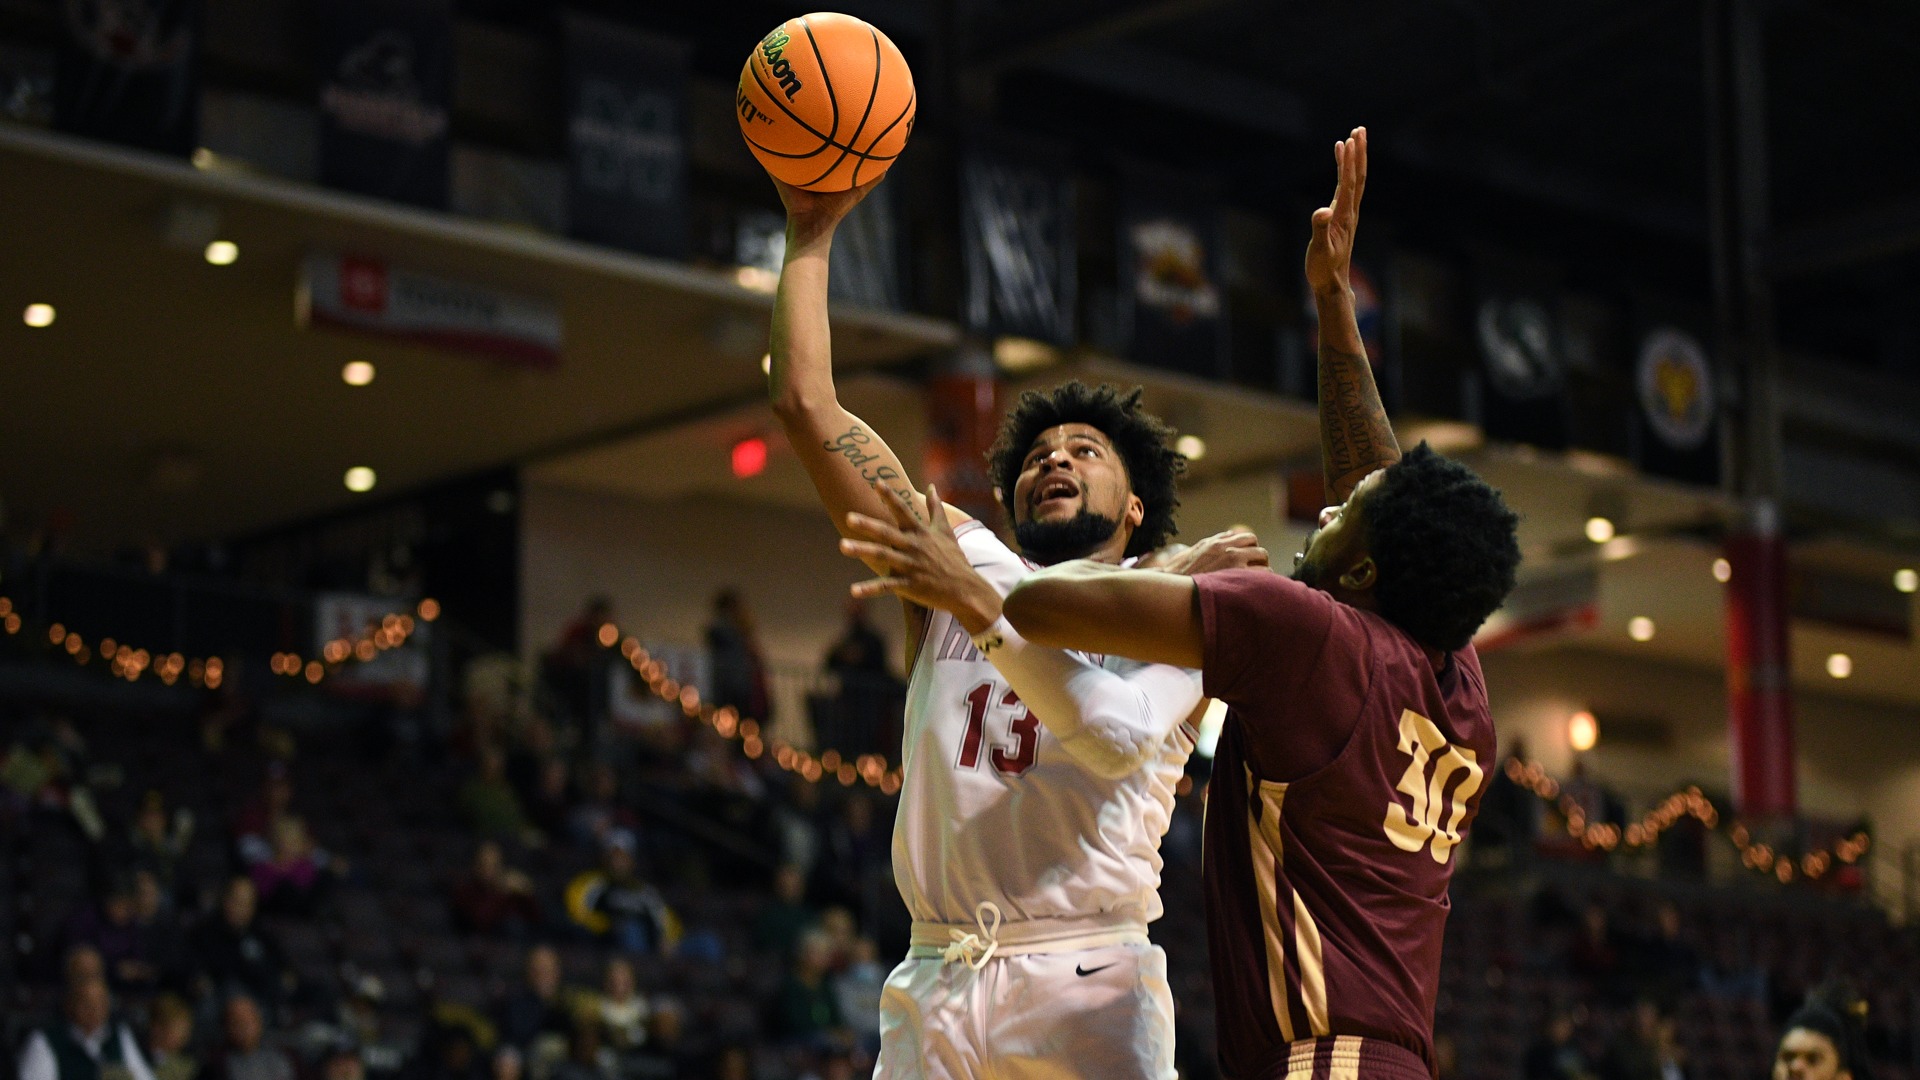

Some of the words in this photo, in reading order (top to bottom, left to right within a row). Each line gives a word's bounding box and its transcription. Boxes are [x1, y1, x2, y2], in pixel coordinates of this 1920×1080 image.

[756, 111, 776, 126] NXT
[823, 426, 879, 468] God
[954, 678, 1043, 779] 13
[1383, 707, 1484, 865] 30
